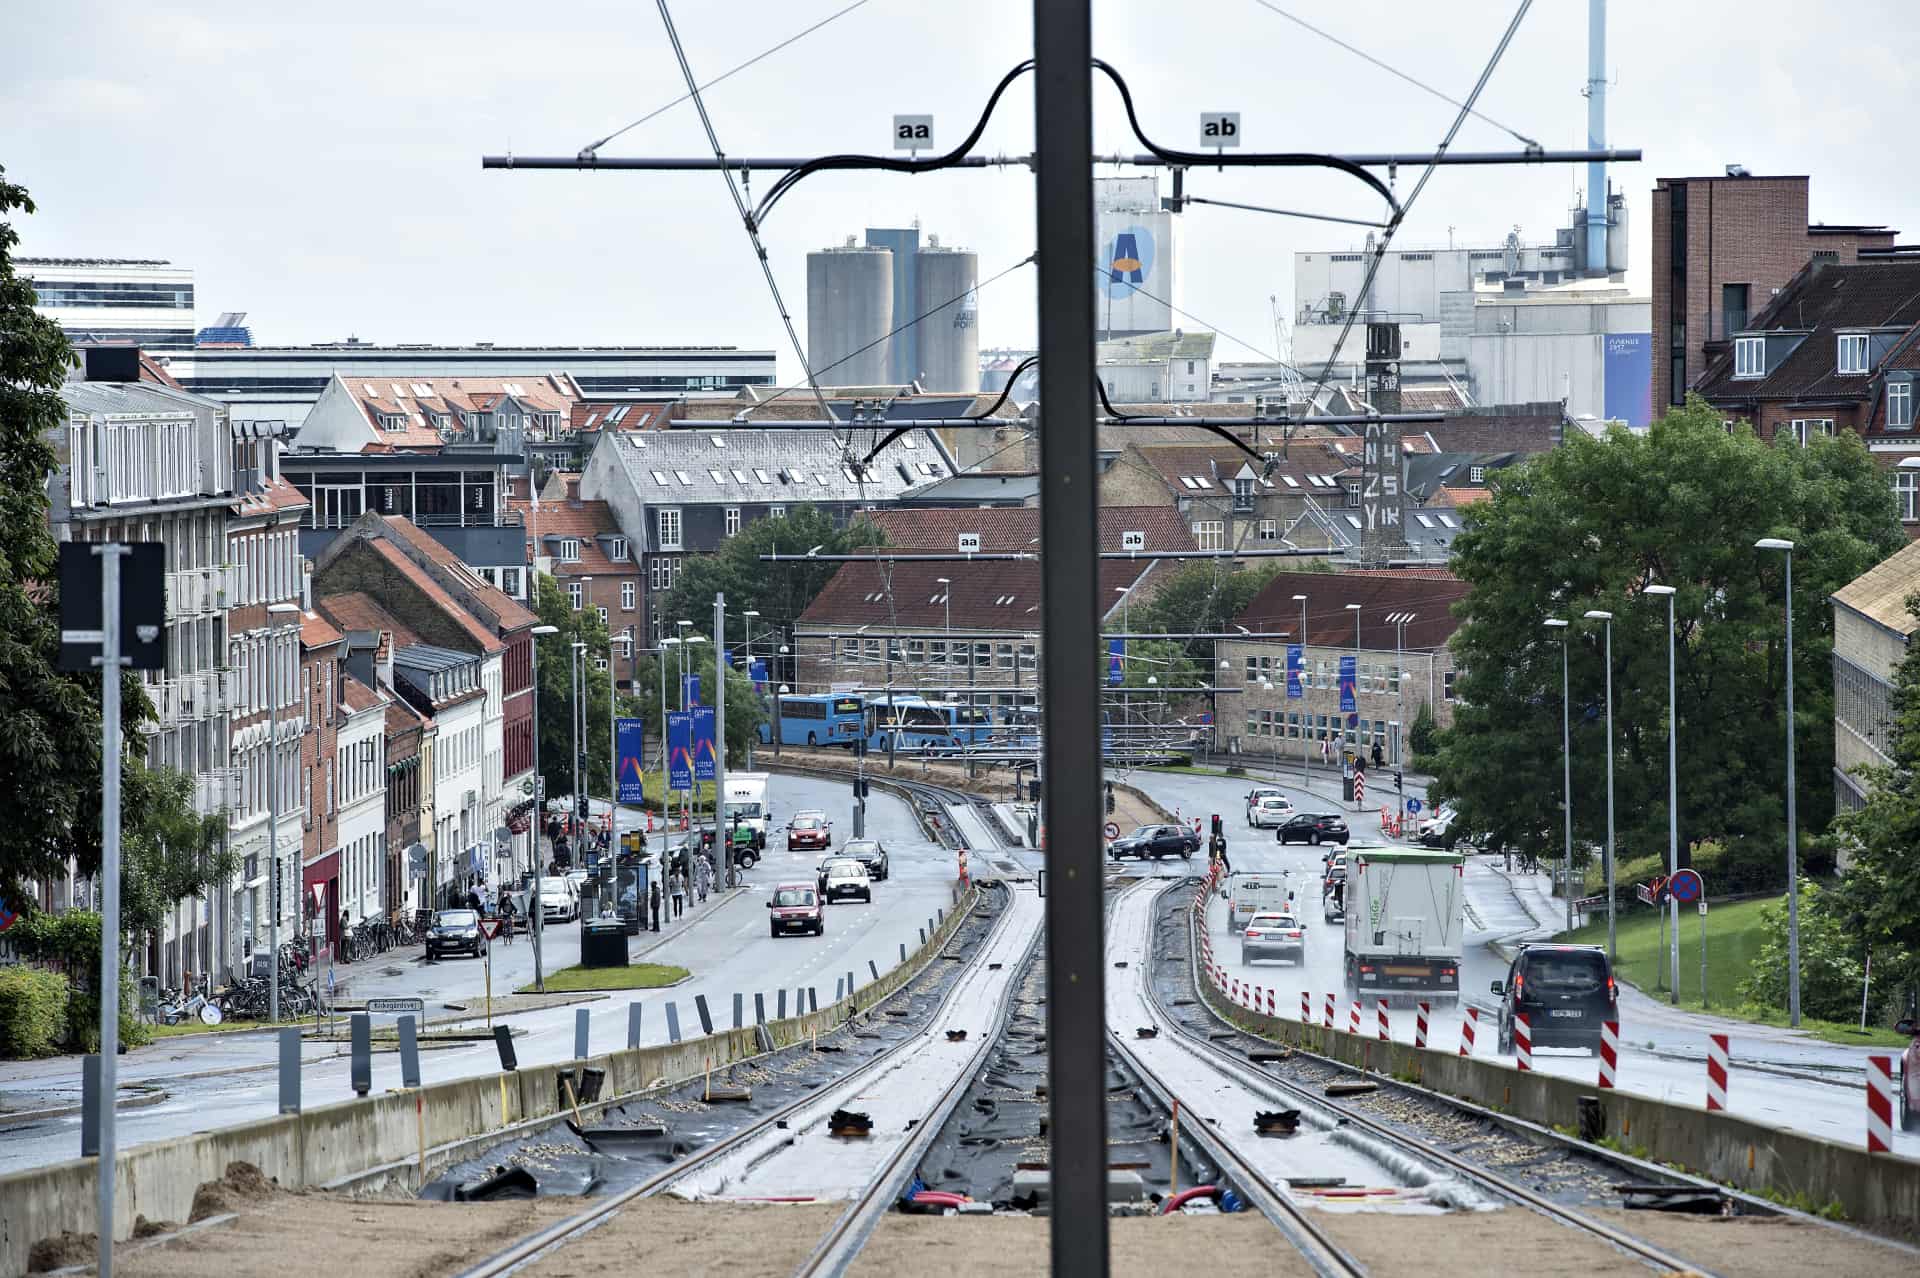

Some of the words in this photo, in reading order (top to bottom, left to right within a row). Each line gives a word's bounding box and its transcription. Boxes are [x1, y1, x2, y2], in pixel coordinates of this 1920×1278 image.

[898, 125, 930, 138] aa
[1204, 118, 1237, 137] ab
[961, 538, 977, 547] aa
[1125, 534, 1142, 545] ab
